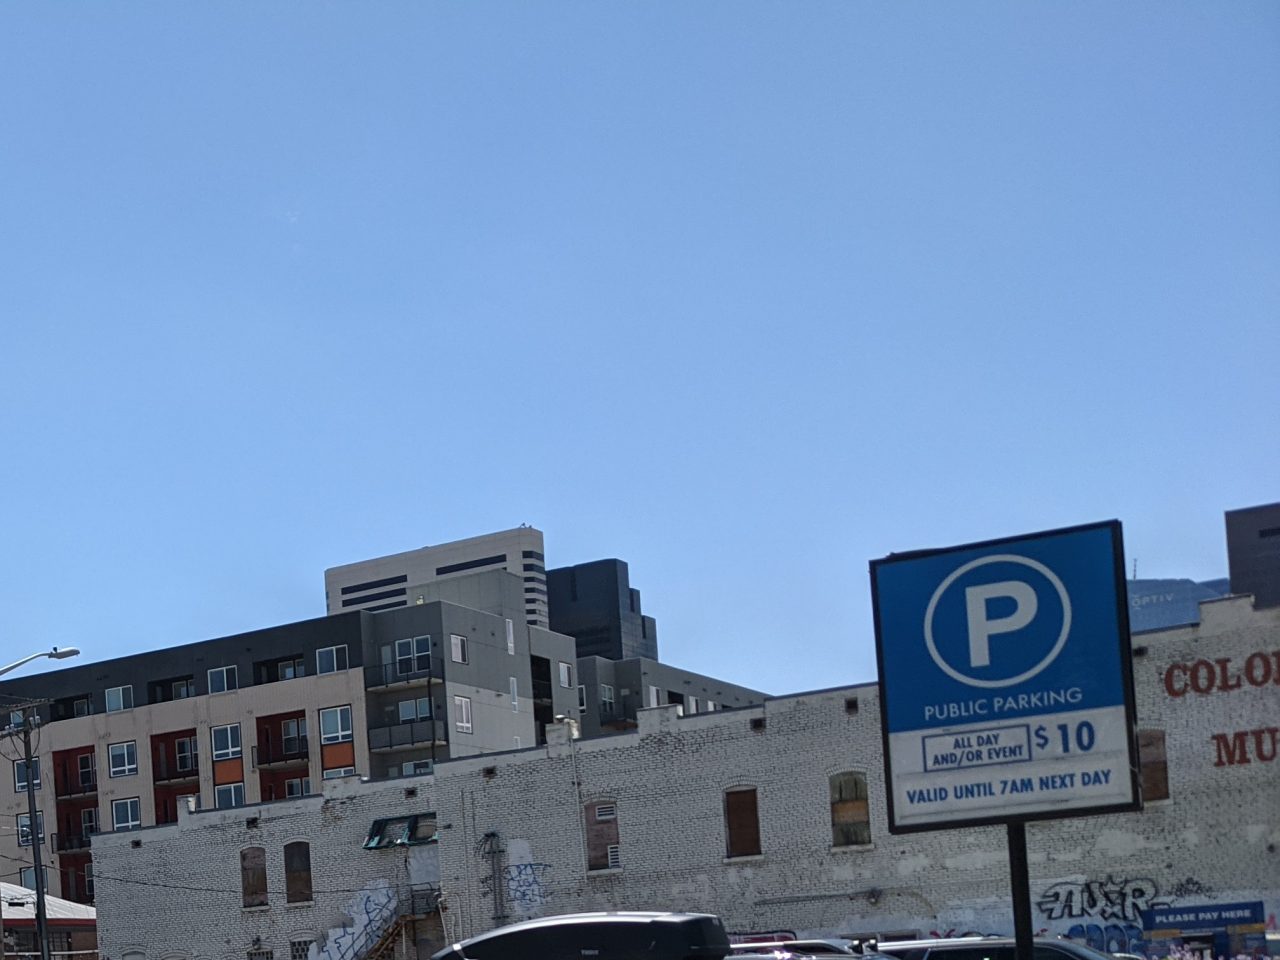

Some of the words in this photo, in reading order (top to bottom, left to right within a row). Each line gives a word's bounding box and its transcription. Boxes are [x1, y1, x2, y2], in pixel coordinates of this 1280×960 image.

[964, 580, 1039, 668] P
[924, 698, 988, 720] PUBLIC
[993, 687, 1083, 713] PARKING
[953, 736, 973, 749] ALL
[977, 733, 1000, 747] DAY
[932, 751, 983, 767] AND/OR
[987, 744, 1024, 761] EVENT
[906, 787, 948, 804] VALID
[953, 782, 995, 800] UNTIL
[1000, 777, 1034, 795] 7AM
[1039, 773, 1075, 790] NEXT
[1081, 769, 1112, 786] DAY
[1155, 912, 1196, 923] PLEASE
[1198, 911, 1219, 920] PAY
[1221, 909, 1251, 918] HERE
